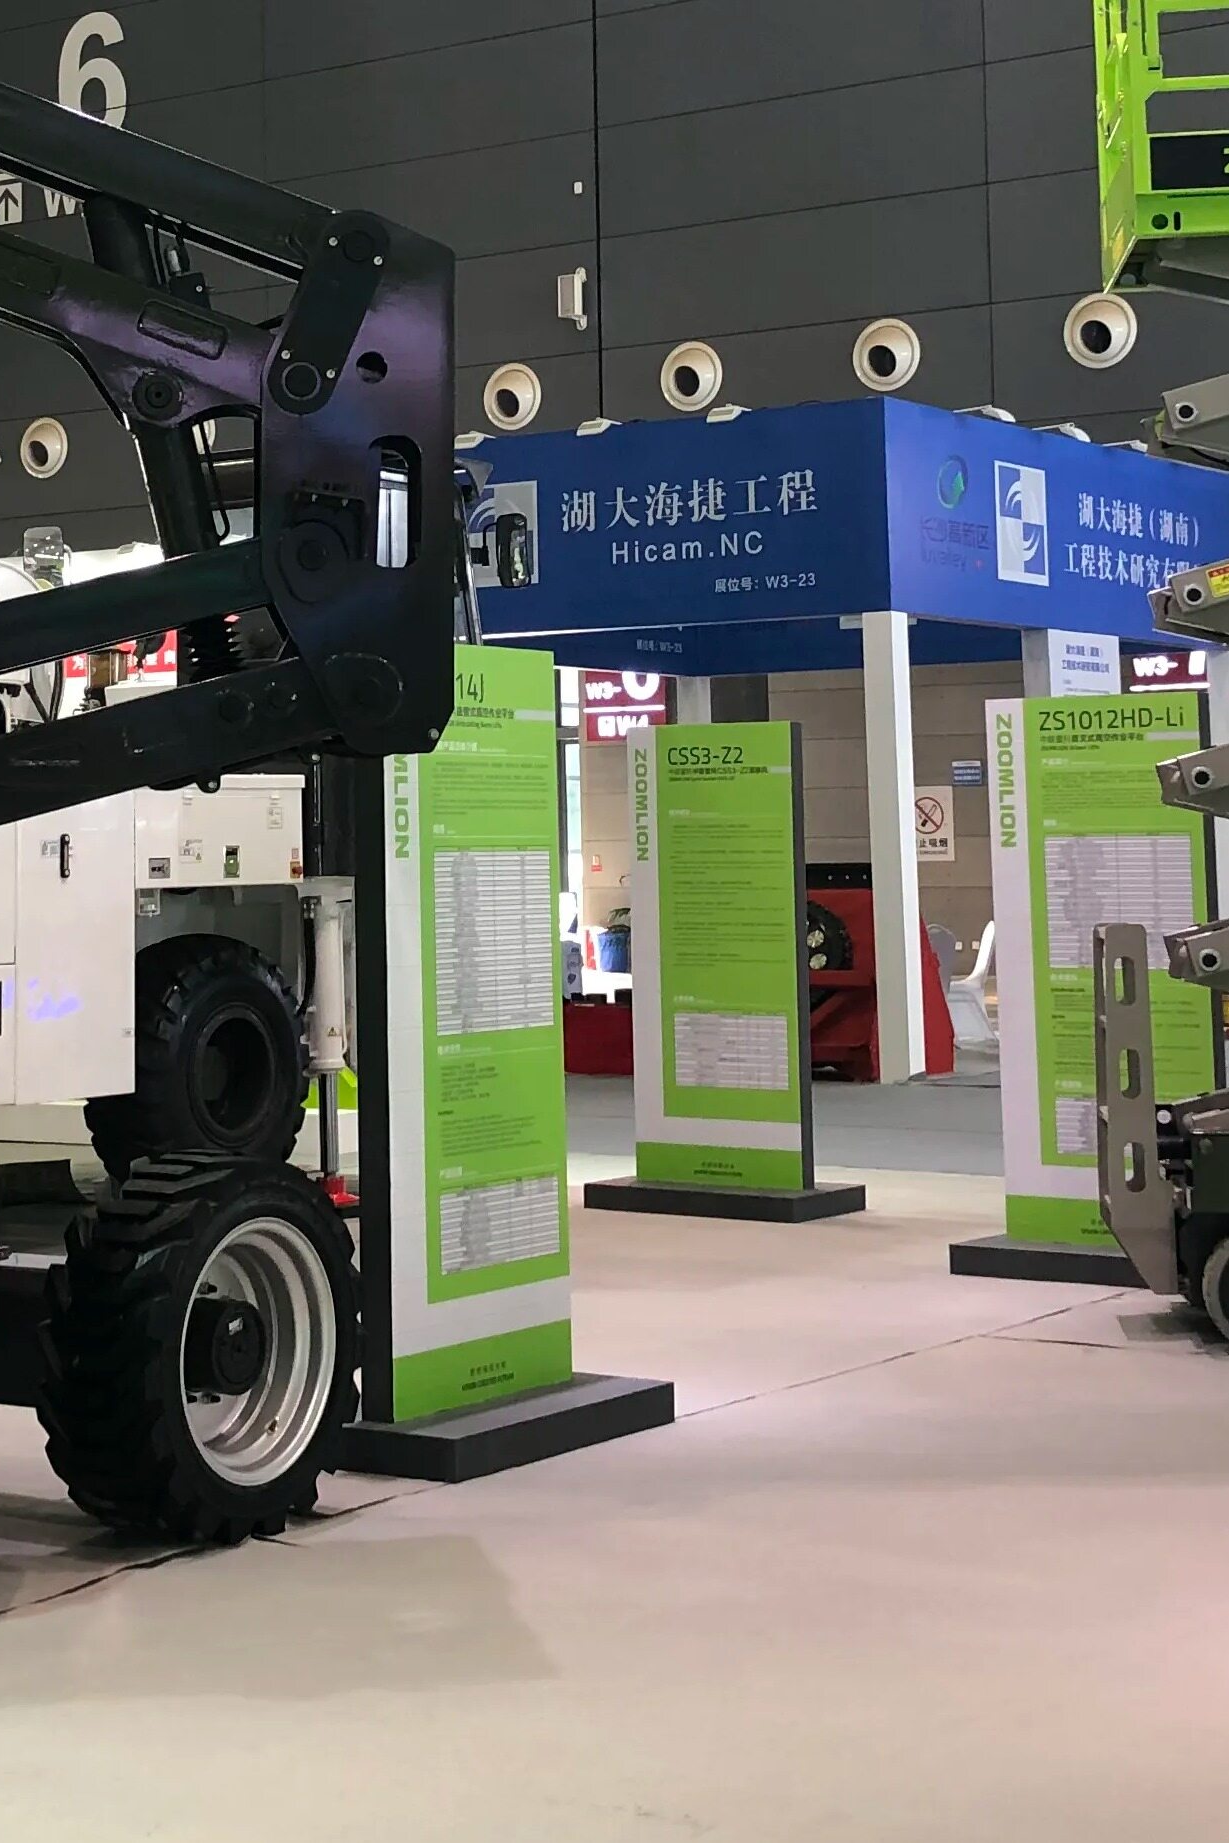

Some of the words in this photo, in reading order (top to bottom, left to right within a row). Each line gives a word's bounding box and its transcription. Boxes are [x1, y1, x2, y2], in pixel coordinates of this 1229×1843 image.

[58, 11, 127, 129] 6
[562, 469, 818, 533] 湖大海捷工程
[612, 531, 763, 565] Hicam.NC
[765, 573, 816, 590] W3-23
[1039, 707, 1184, 731] ZS1012HD-Li
[668, 746, 744, 766] CSS3-Z2
[996, 713, 1017, 848] ZOOMLION
[635, 748, 649, 861] ZOOMLION
